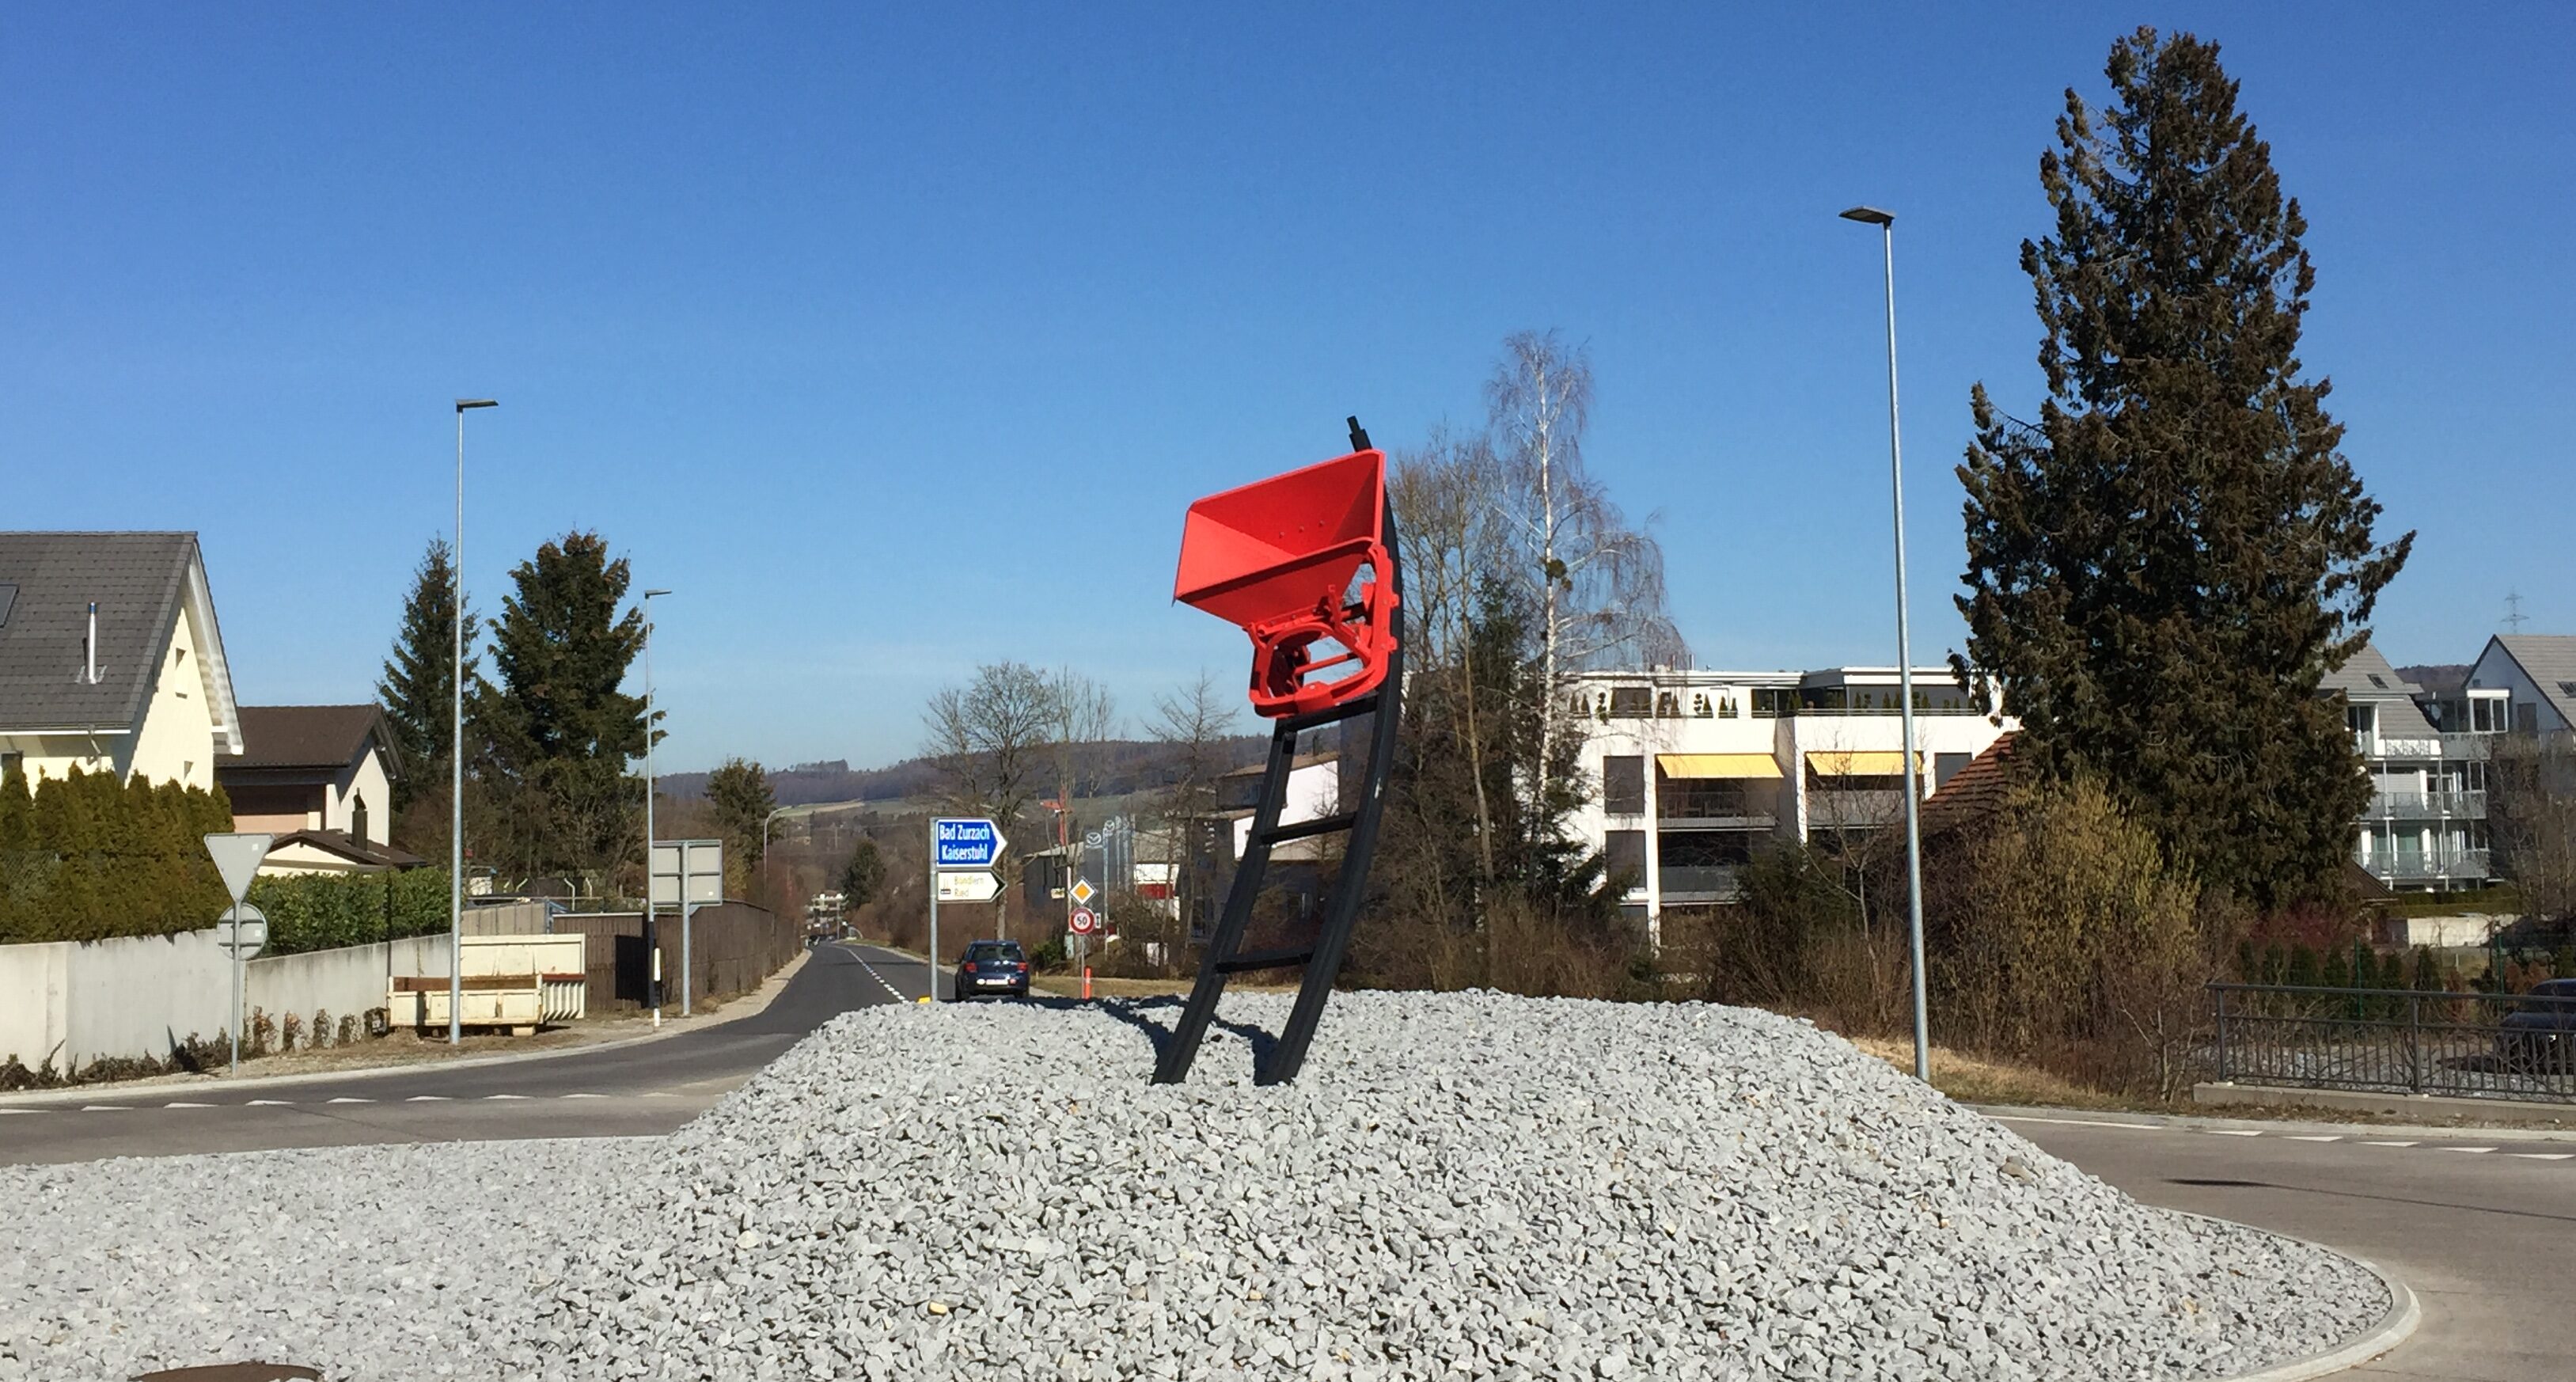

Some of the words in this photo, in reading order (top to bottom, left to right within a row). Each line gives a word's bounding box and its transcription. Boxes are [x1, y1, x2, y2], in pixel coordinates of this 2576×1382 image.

[939, 824, 956, 841] Bad
[958, 824, 990, 841] Zurzach
[941, 843, 988, 860] Kaiserstuhl
[1076, 916, 1088, 926] 50
